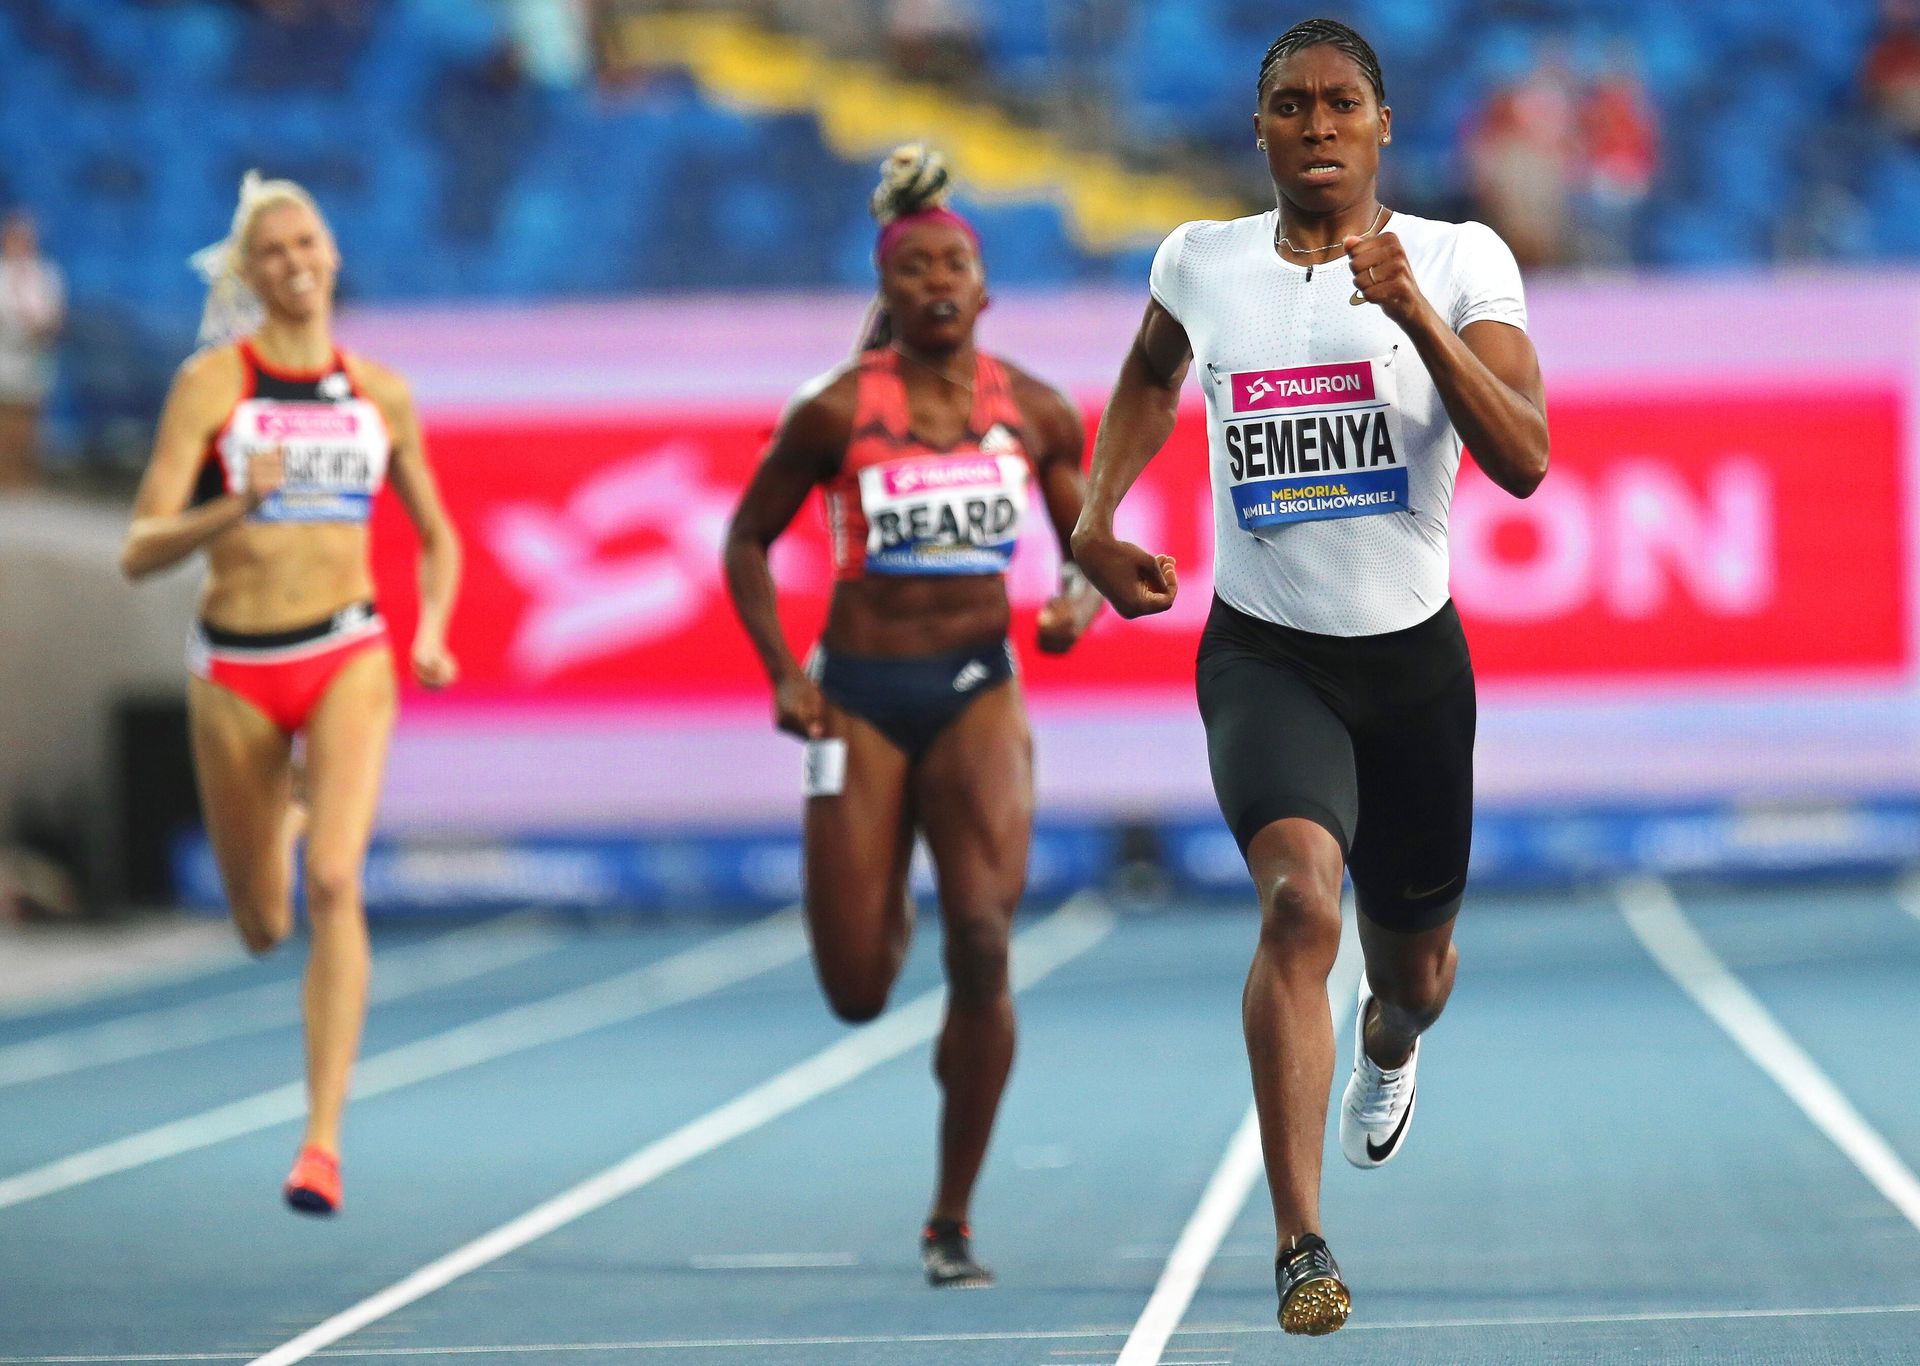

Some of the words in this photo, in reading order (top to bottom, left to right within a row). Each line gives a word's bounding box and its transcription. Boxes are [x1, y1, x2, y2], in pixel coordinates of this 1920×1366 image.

[1276, 374, 1360, 396] TAURON
[1225, 411, 1396, 481] SEMENYA
[1271, 484, 1348, 501] MEMORIAŁ
[1279, 491, 1396, 514] SKOLIMOWSKIEJ
[872, 497, 1017, 550] BEARD
